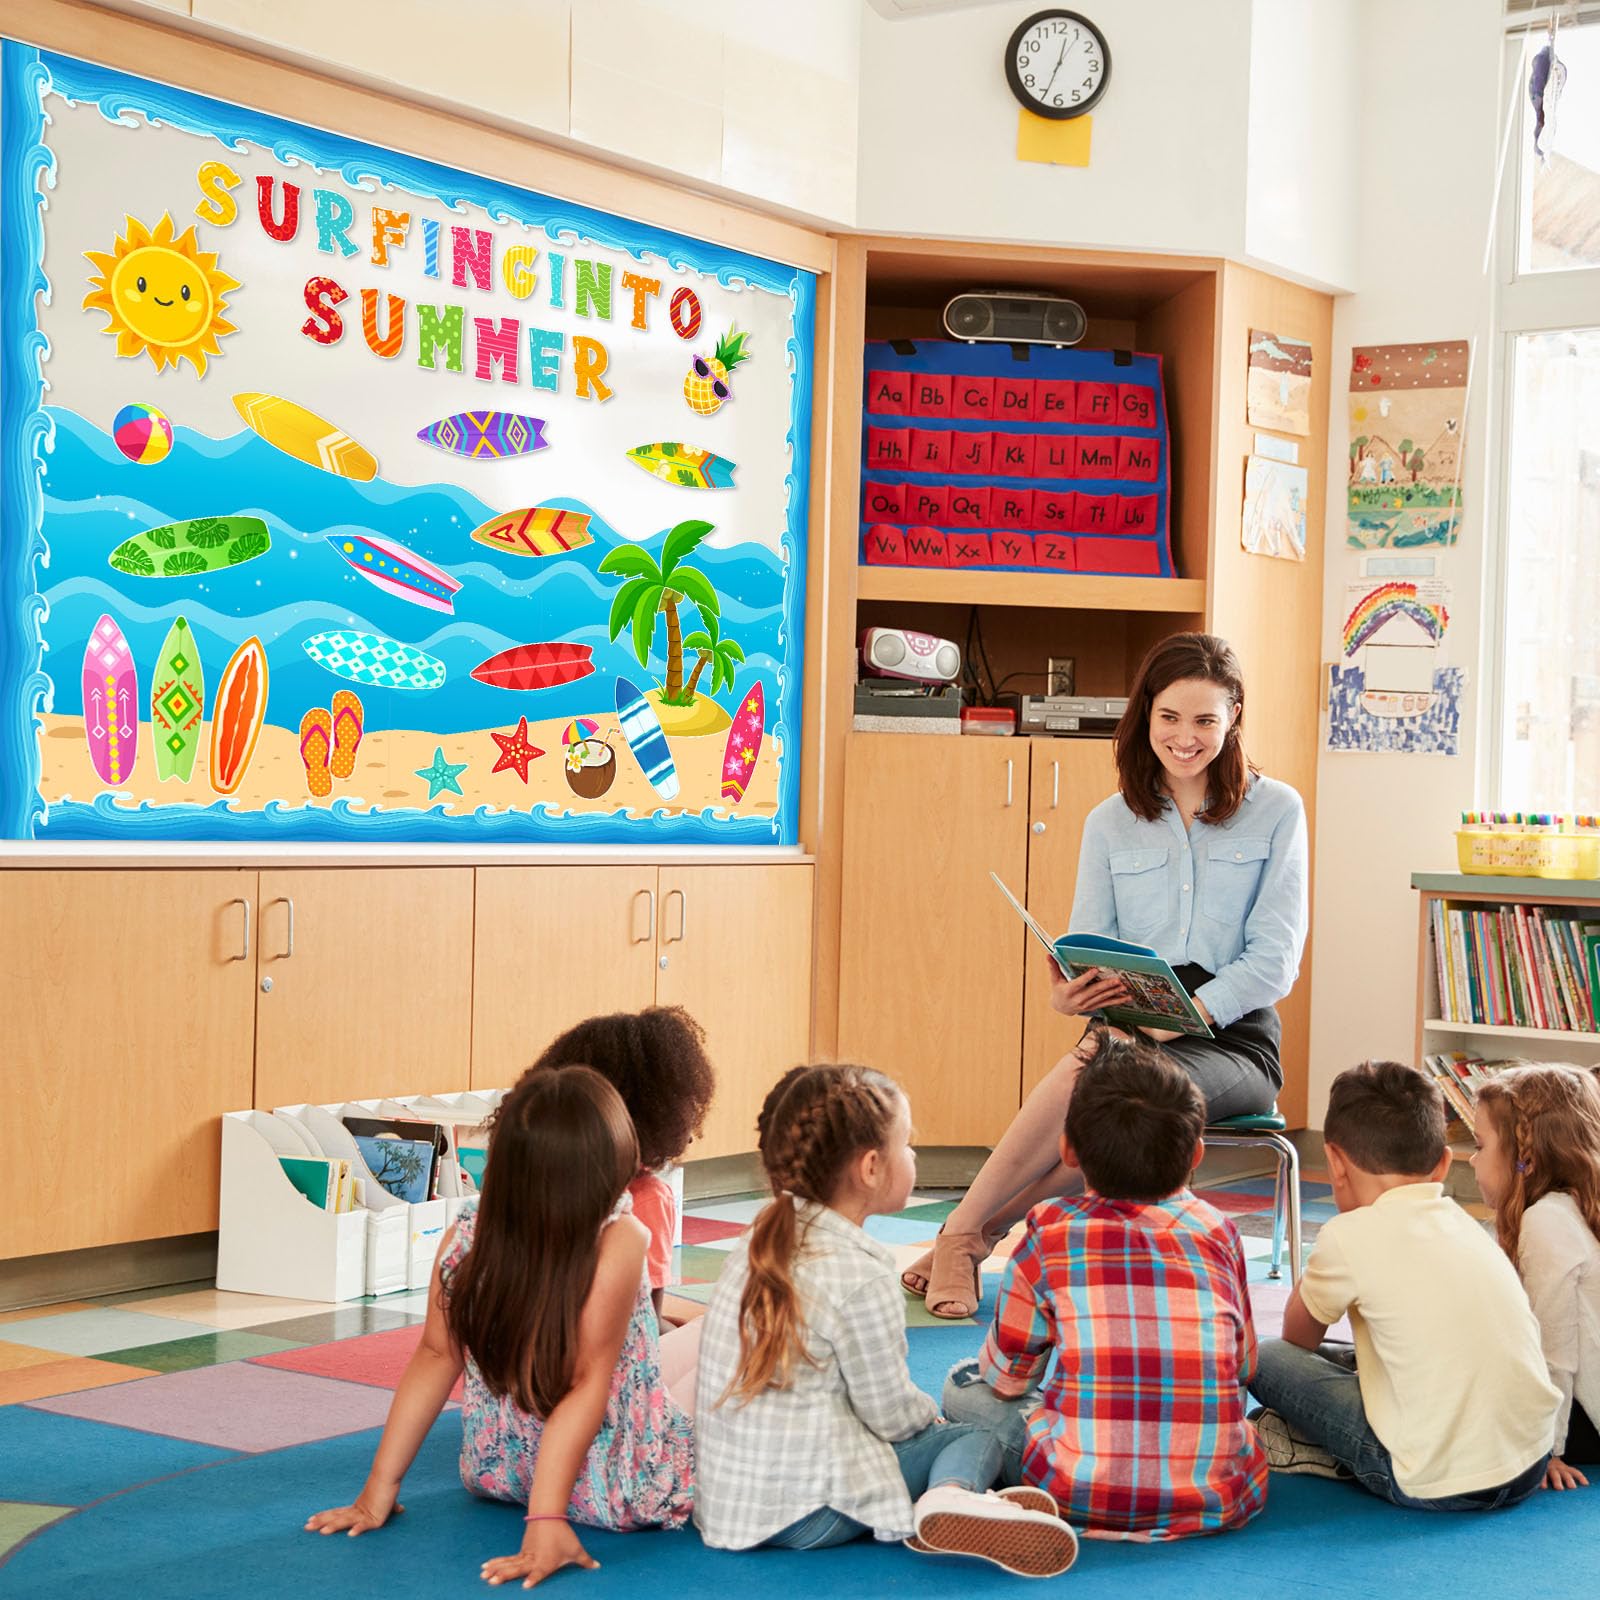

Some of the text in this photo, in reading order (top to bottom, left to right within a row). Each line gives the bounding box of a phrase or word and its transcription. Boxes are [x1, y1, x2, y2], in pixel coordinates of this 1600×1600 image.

[1036, 27, 1048, 39] 11
[1052, 22, 1067, 34] 12
[1074, 28, 1080, 40] 1
[1024, 40, 1040, 52] 10
[1084, 41, 1093, 54] 2
[1019, 56, 1029, 68] 9
[1088, 60, 1099, 72] 3
[1024, 74, 1035, 88] 8
[1082, 77, 1093, 90] 4
[1039, 89, 1048, 101] 7
[1053, 94, 1063, 106] 6
[1071, 90, 1081, 101] 5
[300, 275, 614, 402] SUMMER
[878, 384, 1149, 418] Aa Bb Cc Dd Ee Ff Gg
[878, 442, 1151, 469] Hh Ii Jj Kk Ll Mm Nn
[871, 495, 1144, 525] Oo Pp Qq Rr Ss Tt Uu
[876, 536, 1066, 561] Vv Ww Xx Yy Zz
